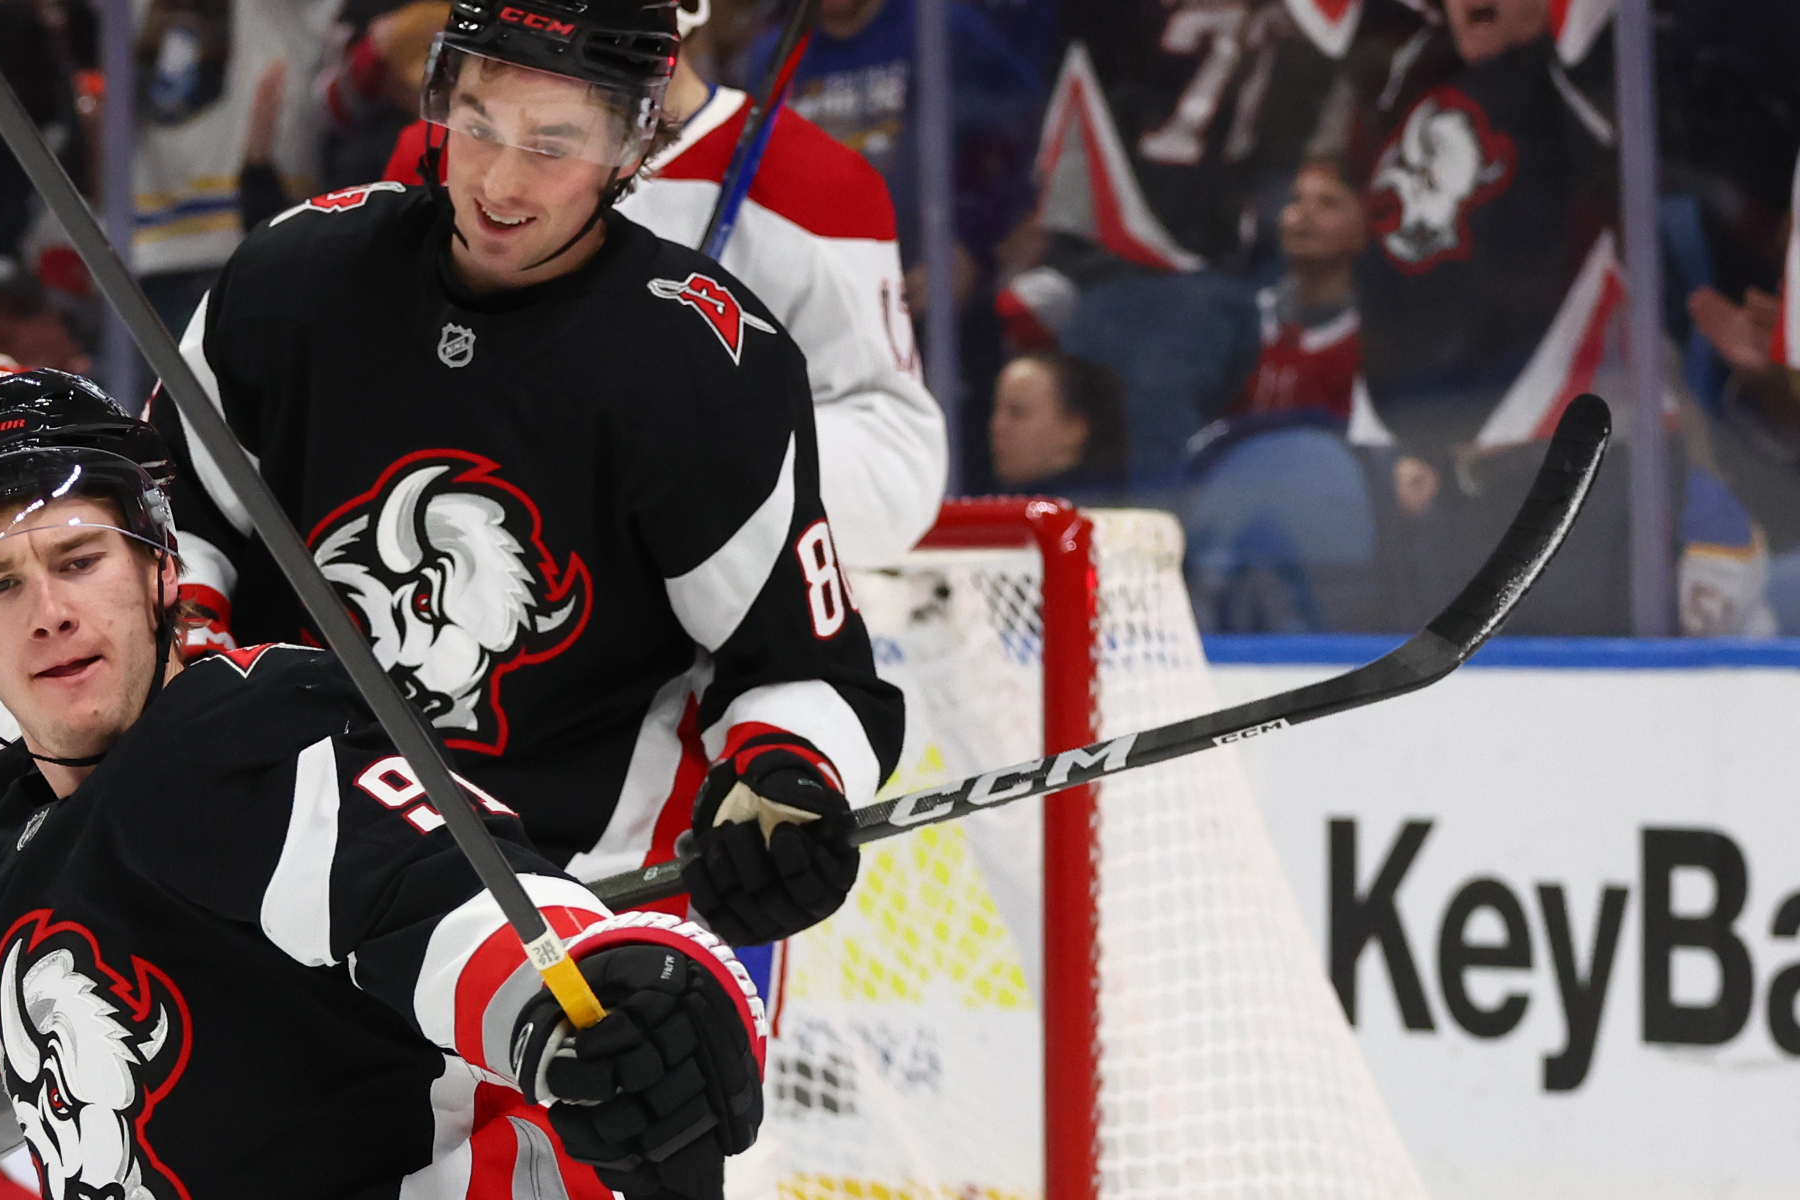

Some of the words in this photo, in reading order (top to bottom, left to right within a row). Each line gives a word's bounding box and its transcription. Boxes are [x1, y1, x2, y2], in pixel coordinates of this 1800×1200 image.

[500, 6, 576, 36] CCM
[1221, 721, 1282, 744] CCM
[888, 733, 1140, 827] CCM
